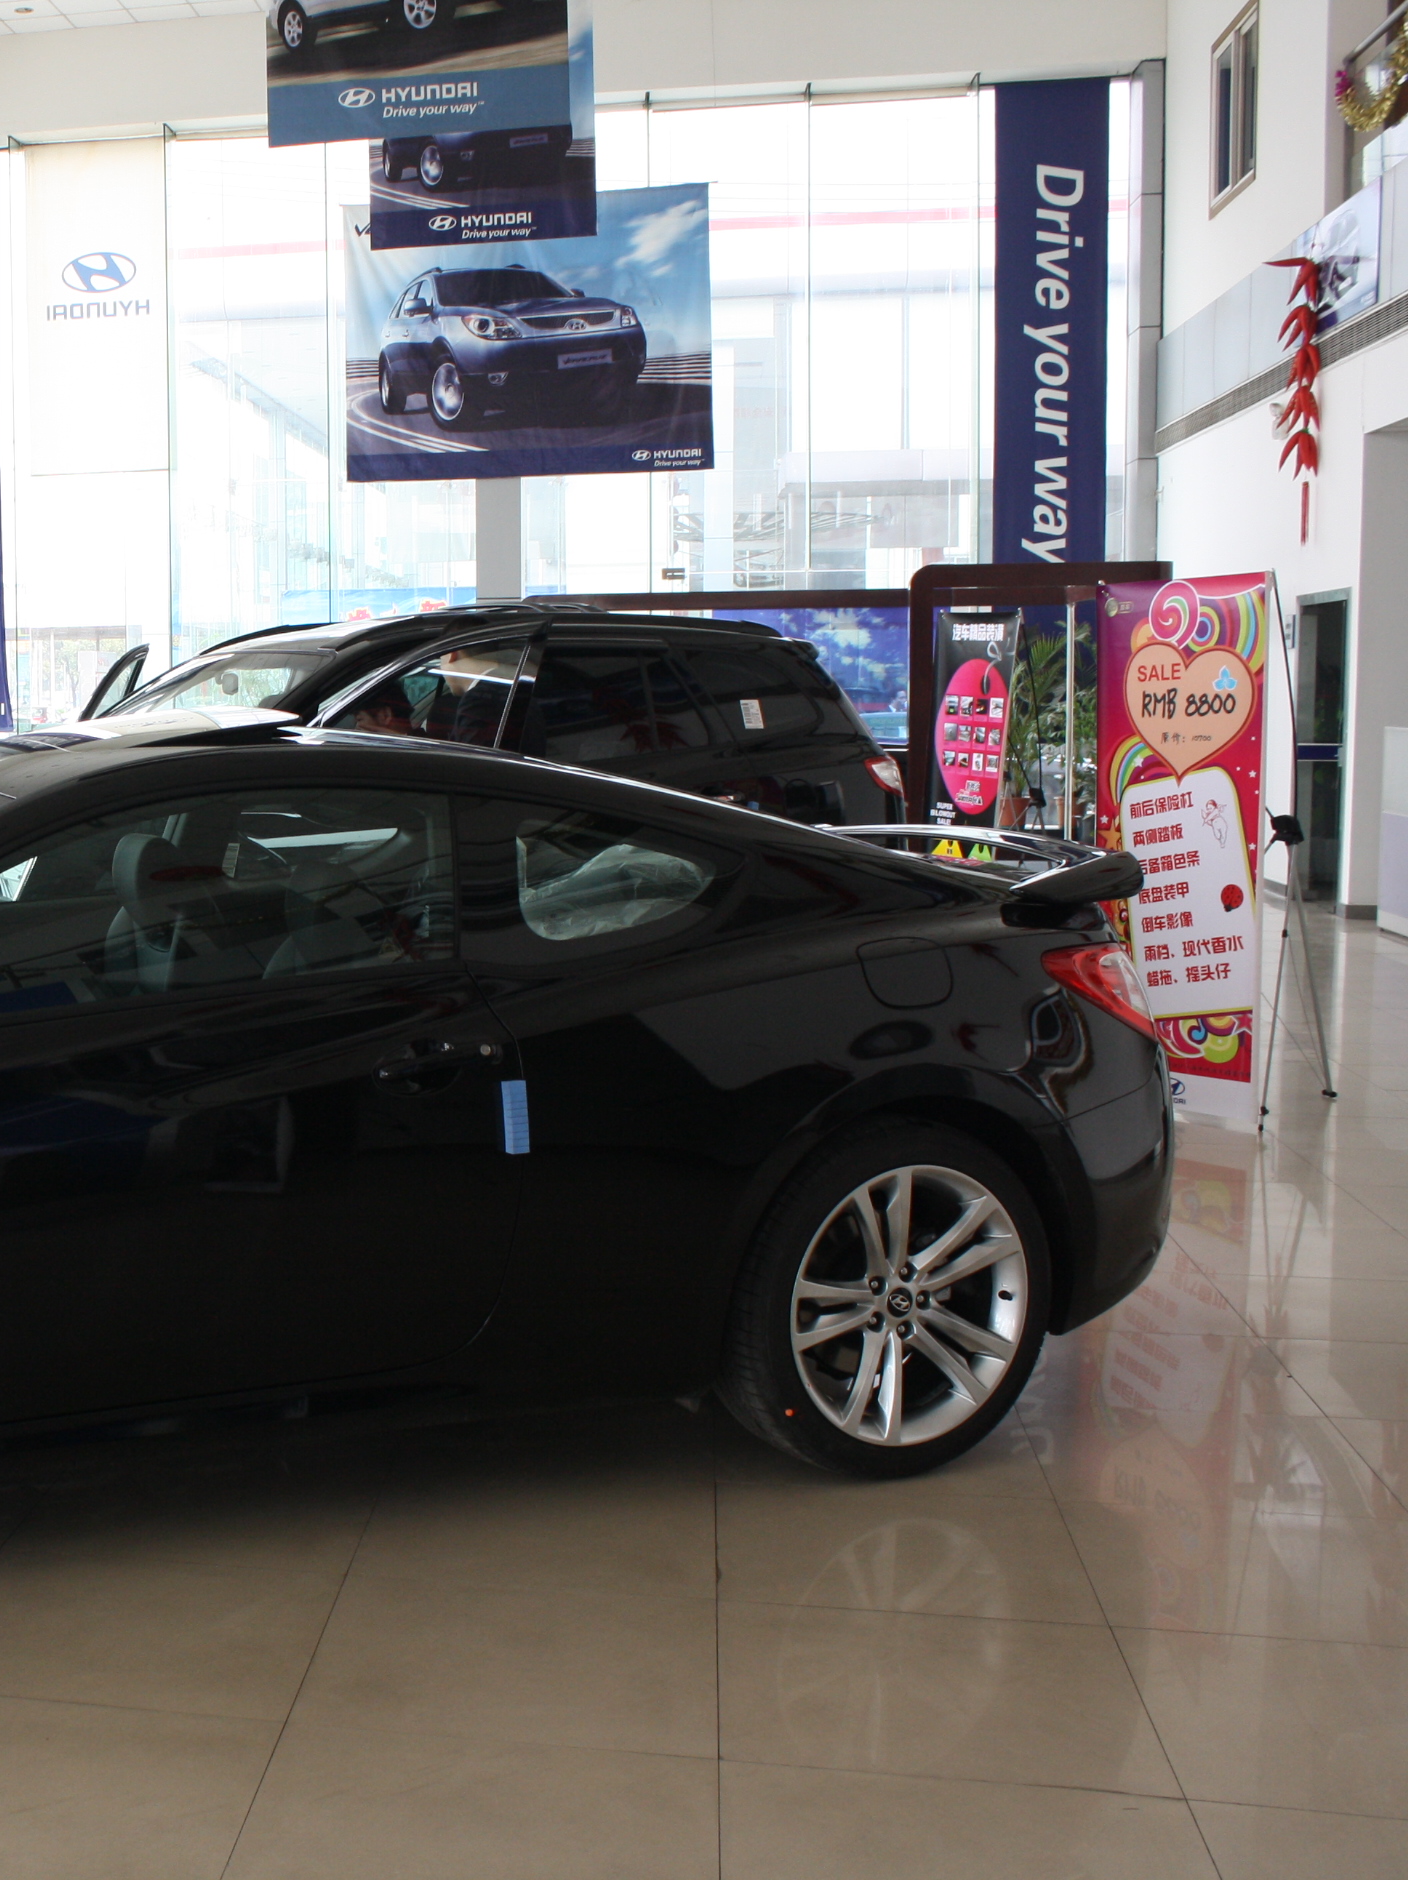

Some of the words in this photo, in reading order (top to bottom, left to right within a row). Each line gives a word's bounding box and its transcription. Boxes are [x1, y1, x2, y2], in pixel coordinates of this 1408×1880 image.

[381, 81, 478, 103] HYUNDAI
[382, 104, 417, 118] Drive
[419, 104, 448, 118] your
[450, 102, 477, 115] way
[461, 212, 532, 228] HYUNDAI
[461, 229, 488, 239] Drive
[488, 229, 510, 238] your
[511, 226, 532, 237] way
[1035, 164, 1084, 310] Drive
[1023, 323, 1069, 446] your
[653, 448, 702, 459] HYUNDAI
[1021, 456, 1068, 563] way
[1137, 662, 1182, 683] SALE
[1141, 687, 1178, 720] RMB
[1184, 693, 1237, 718] 8800
[1129, 790, 1195, 820] 前后保险杠
[1132, 823, 1184, 848] 两侧踏板
[1139, 881, 1190, 905] 底盘装甲
[1141, 911, 1194, 933] 倒车影像
